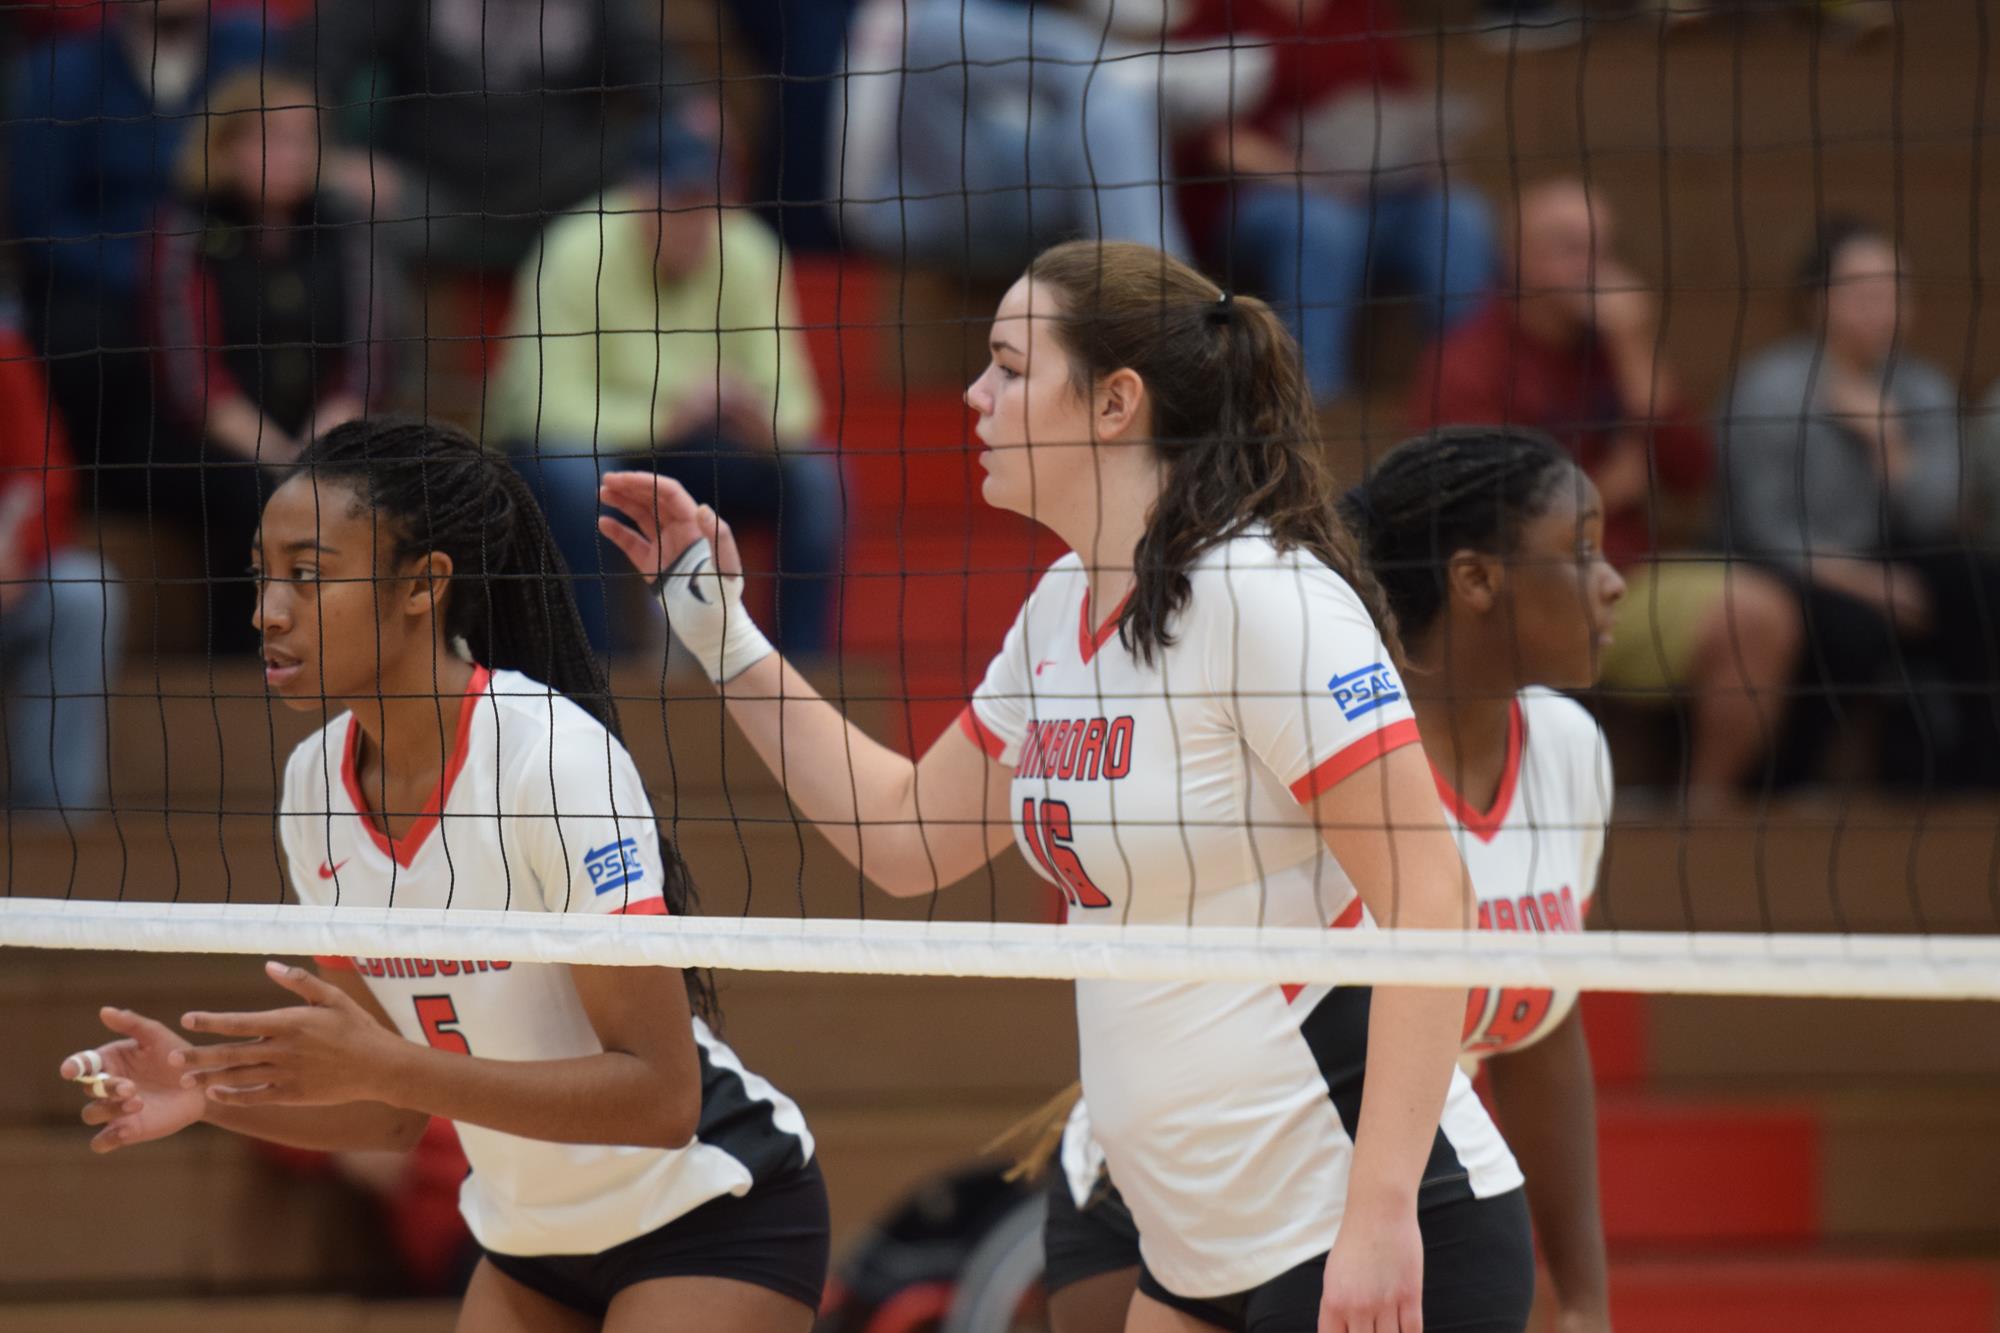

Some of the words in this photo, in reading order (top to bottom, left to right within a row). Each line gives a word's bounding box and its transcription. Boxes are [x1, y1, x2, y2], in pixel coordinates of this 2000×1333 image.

[1333, 671, 1397, 711] PSAC
[586, 848, 641, 885] PSAC
[1022, 798, 1112, 908] 16
[412, 994, 472, 1056] 5
